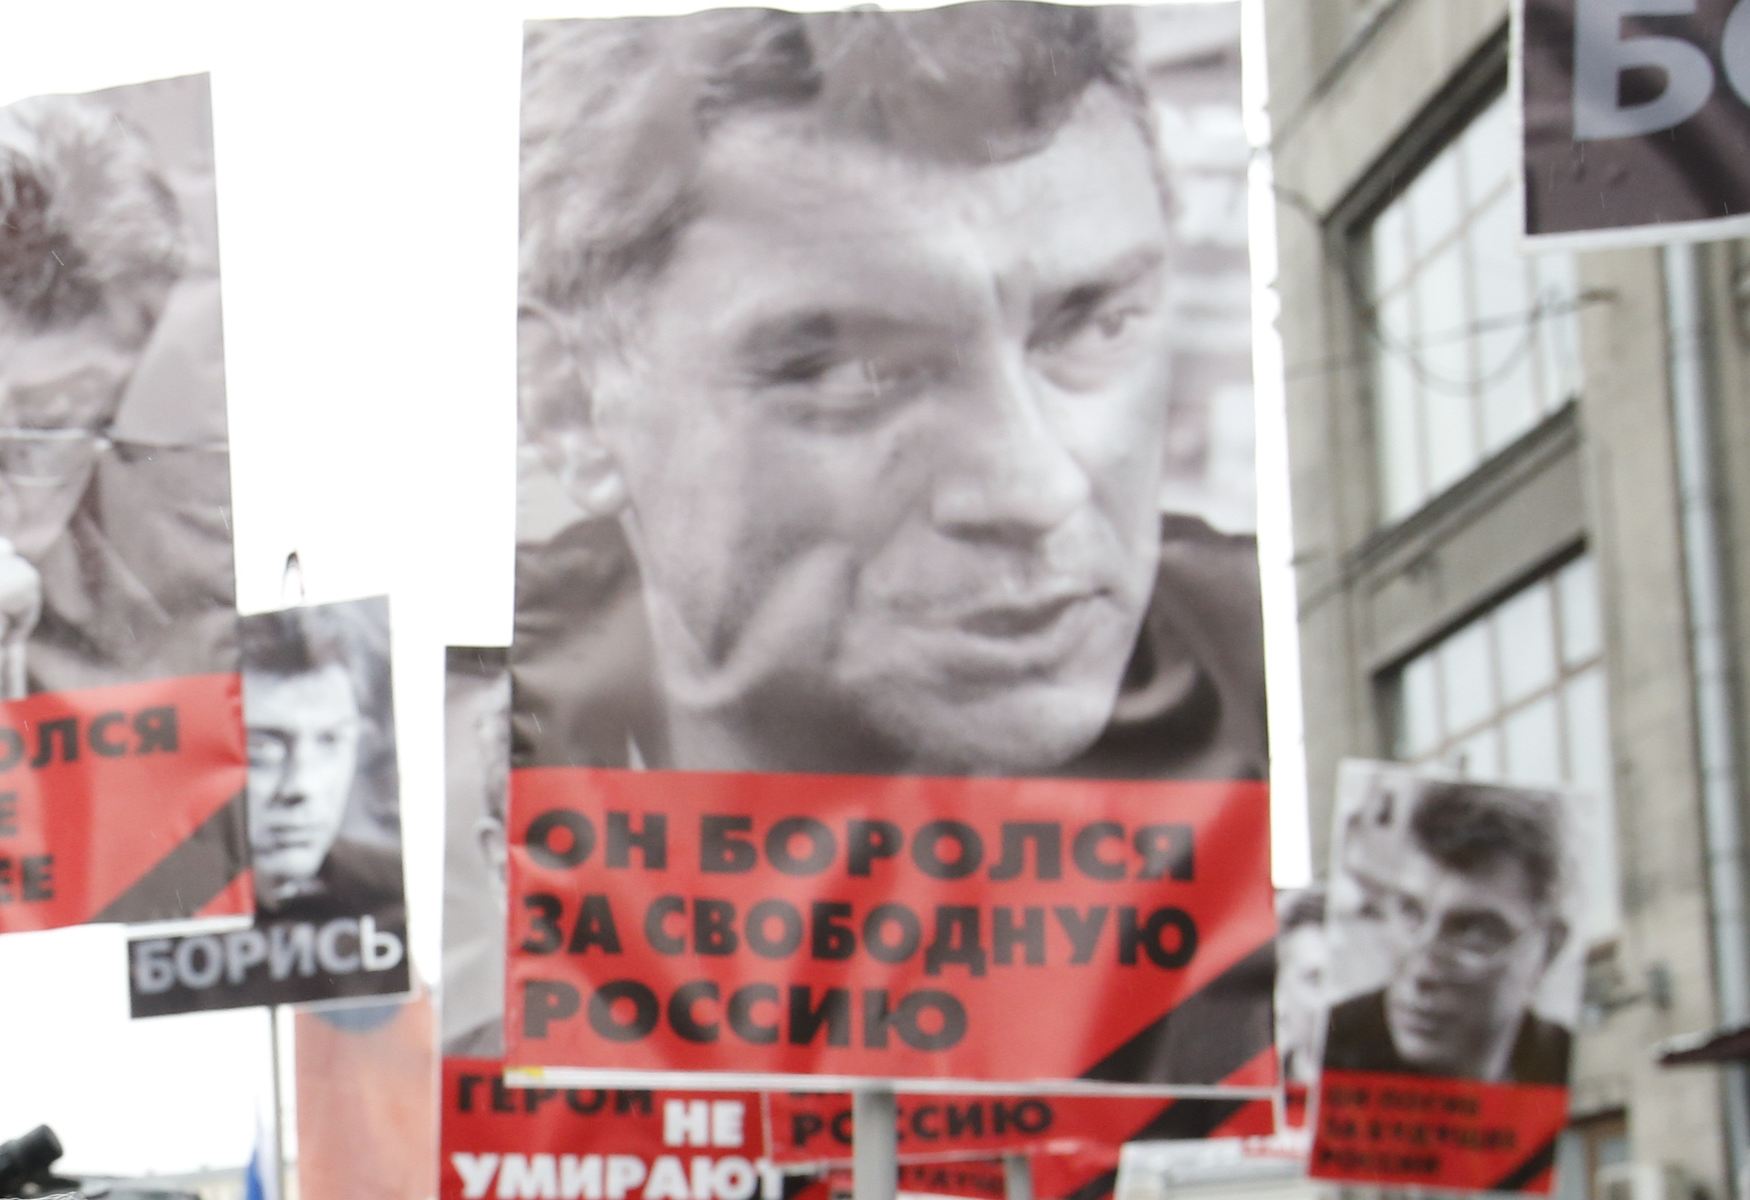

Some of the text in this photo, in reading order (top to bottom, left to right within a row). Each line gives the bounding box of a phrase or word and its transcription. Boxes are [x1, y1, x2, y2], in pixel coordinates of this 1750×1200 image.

[1572, 0, 1750, 140] Б
[525, 809, 1195, 882] ОН БОРОЛСЯ
[135, 914, 403, 993] БОРИСЬ
[521, 893, 1198, 978] ЗА СВОБОДНУЮ
[522, 978, 968, 1052] РОССИЮ
[458, 1074, 654, 1115] ГЕРОИ
[662, 1099, 746, 1148] НЕ
[792, 1100, 1053, 1147] РОСИЮ
